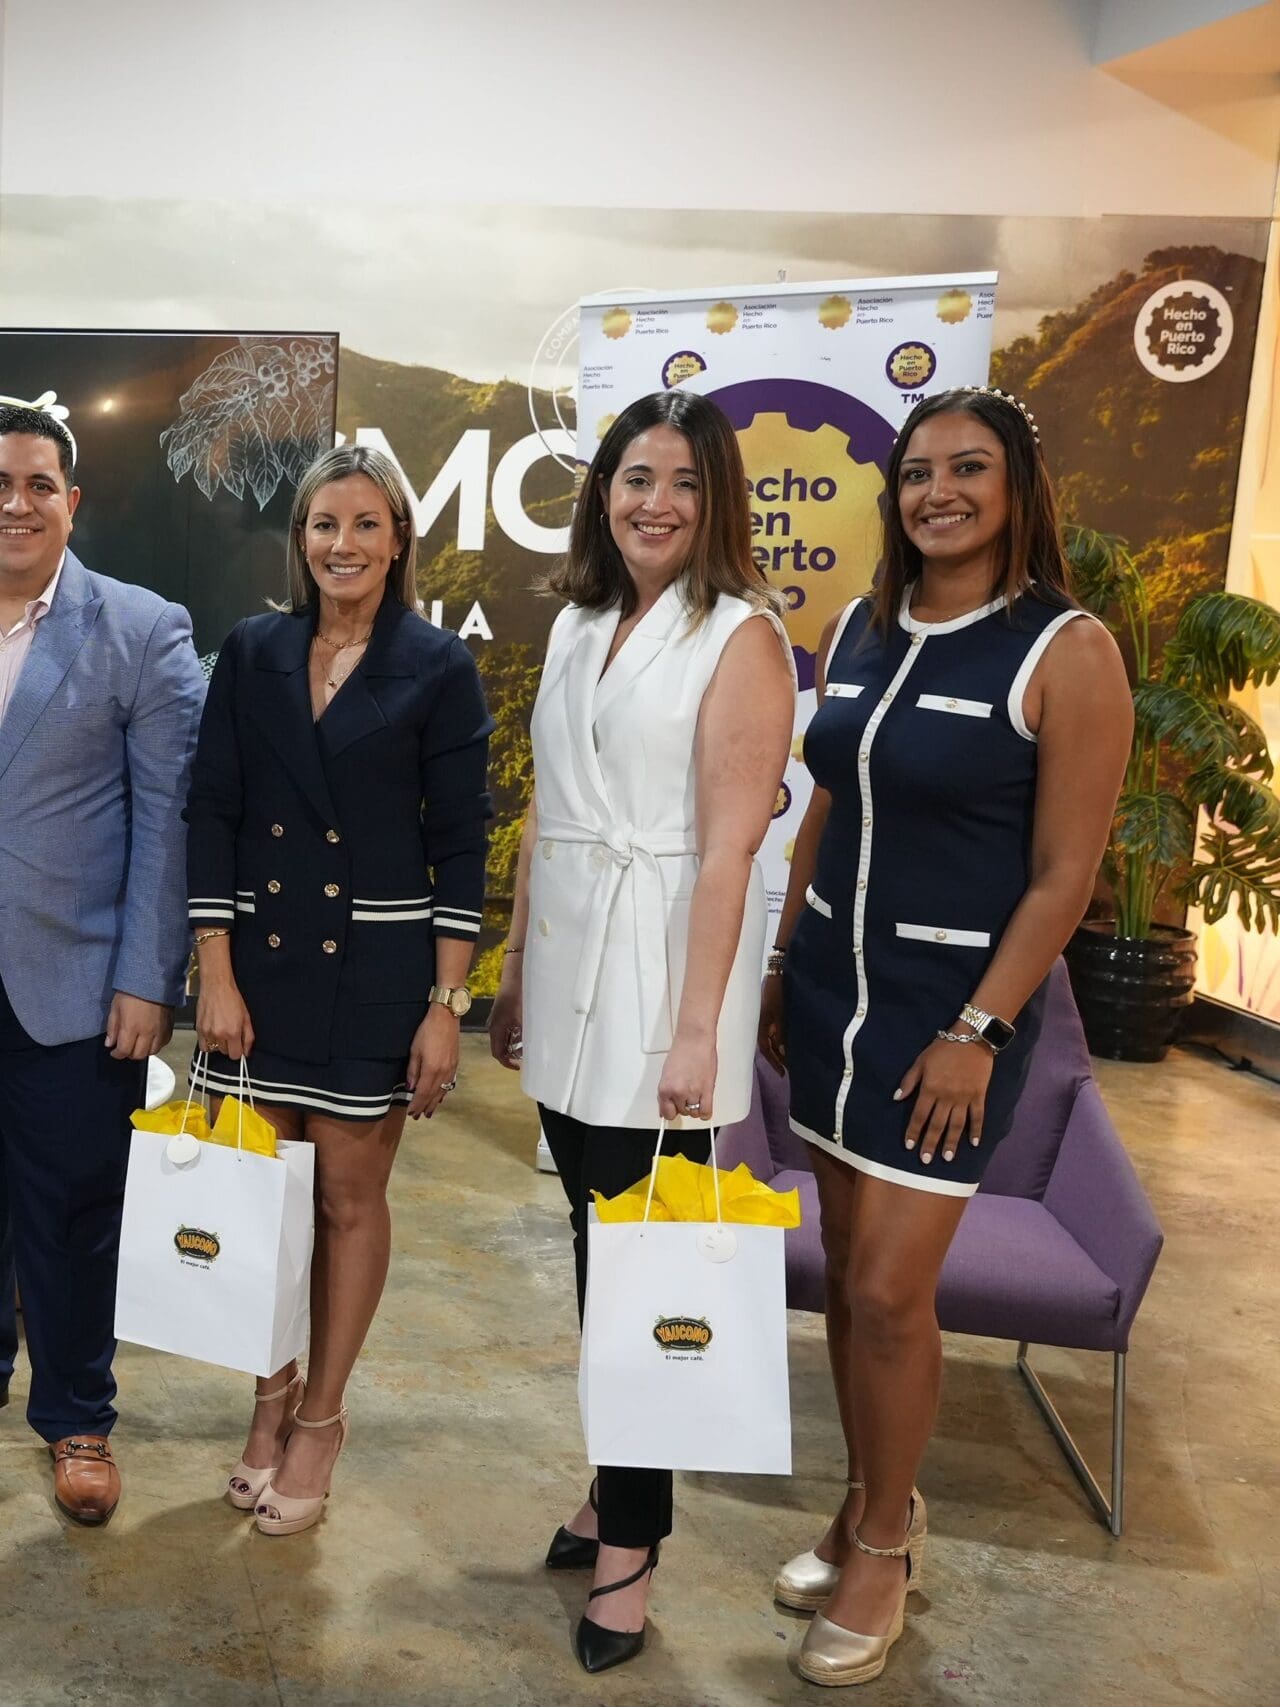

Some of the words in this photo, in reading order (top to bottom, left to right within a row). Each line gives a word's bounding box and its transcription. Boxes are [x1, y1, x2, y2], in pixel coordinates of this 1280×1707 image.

[1163, 308, 1207, 321] Hecho
[1175, 322, 1194, 331] en
[1160, 330, 1206, 343] Puerto
[1166, 343, 1197, 355] Rico
[656, 1325, 709, 1343] YAUCONO
